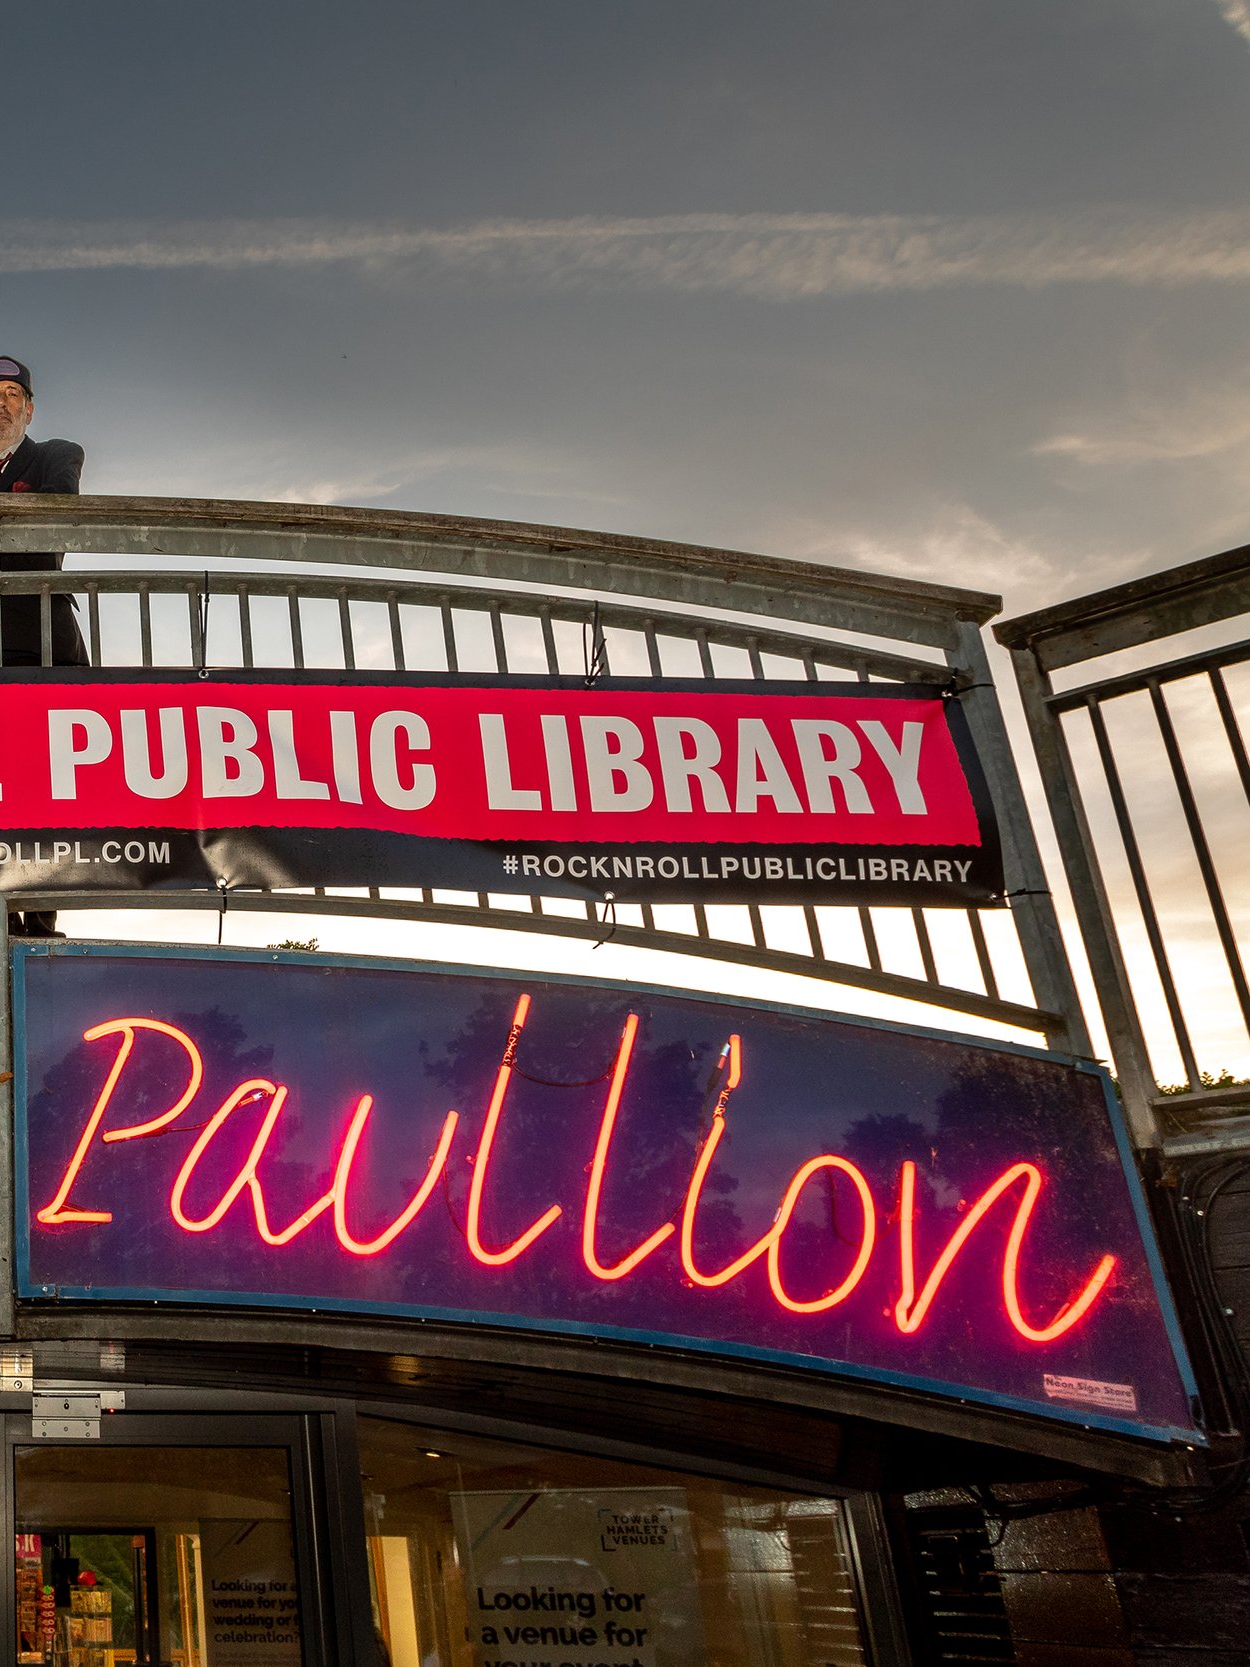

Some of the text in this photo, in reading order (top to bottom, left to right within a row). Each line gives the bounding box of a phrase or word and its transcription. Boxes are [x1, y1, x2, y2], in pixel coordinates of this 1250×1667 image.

[47, 705, 437, 811] PUBLIC
[477, 712, 928, 816] LIBRARY
[502, 853, 974, 885] #ROCKNROLLPUBLICLIBRARY
[1046, 1377, 1074, 1389] Neon
[1077, 1382, 1101, 1394] Sign
[612, 1515, 660, 1524] TOWER
[606, 1525, 668, 1535] HAMLETS
[612, 1535, 666, 1545] VENUES
[211, 1579, 266, 1594] Looking
[212, 1598, 255, 1609] venue
[257, 1596, 277, 1609] for
[477, 1587, 647, 1618] Looking for
[213, 1614, 274, 1629] wedding
[276, 1616, 292, 1626] or
[481, 1622, 648, 1647] a venue for
